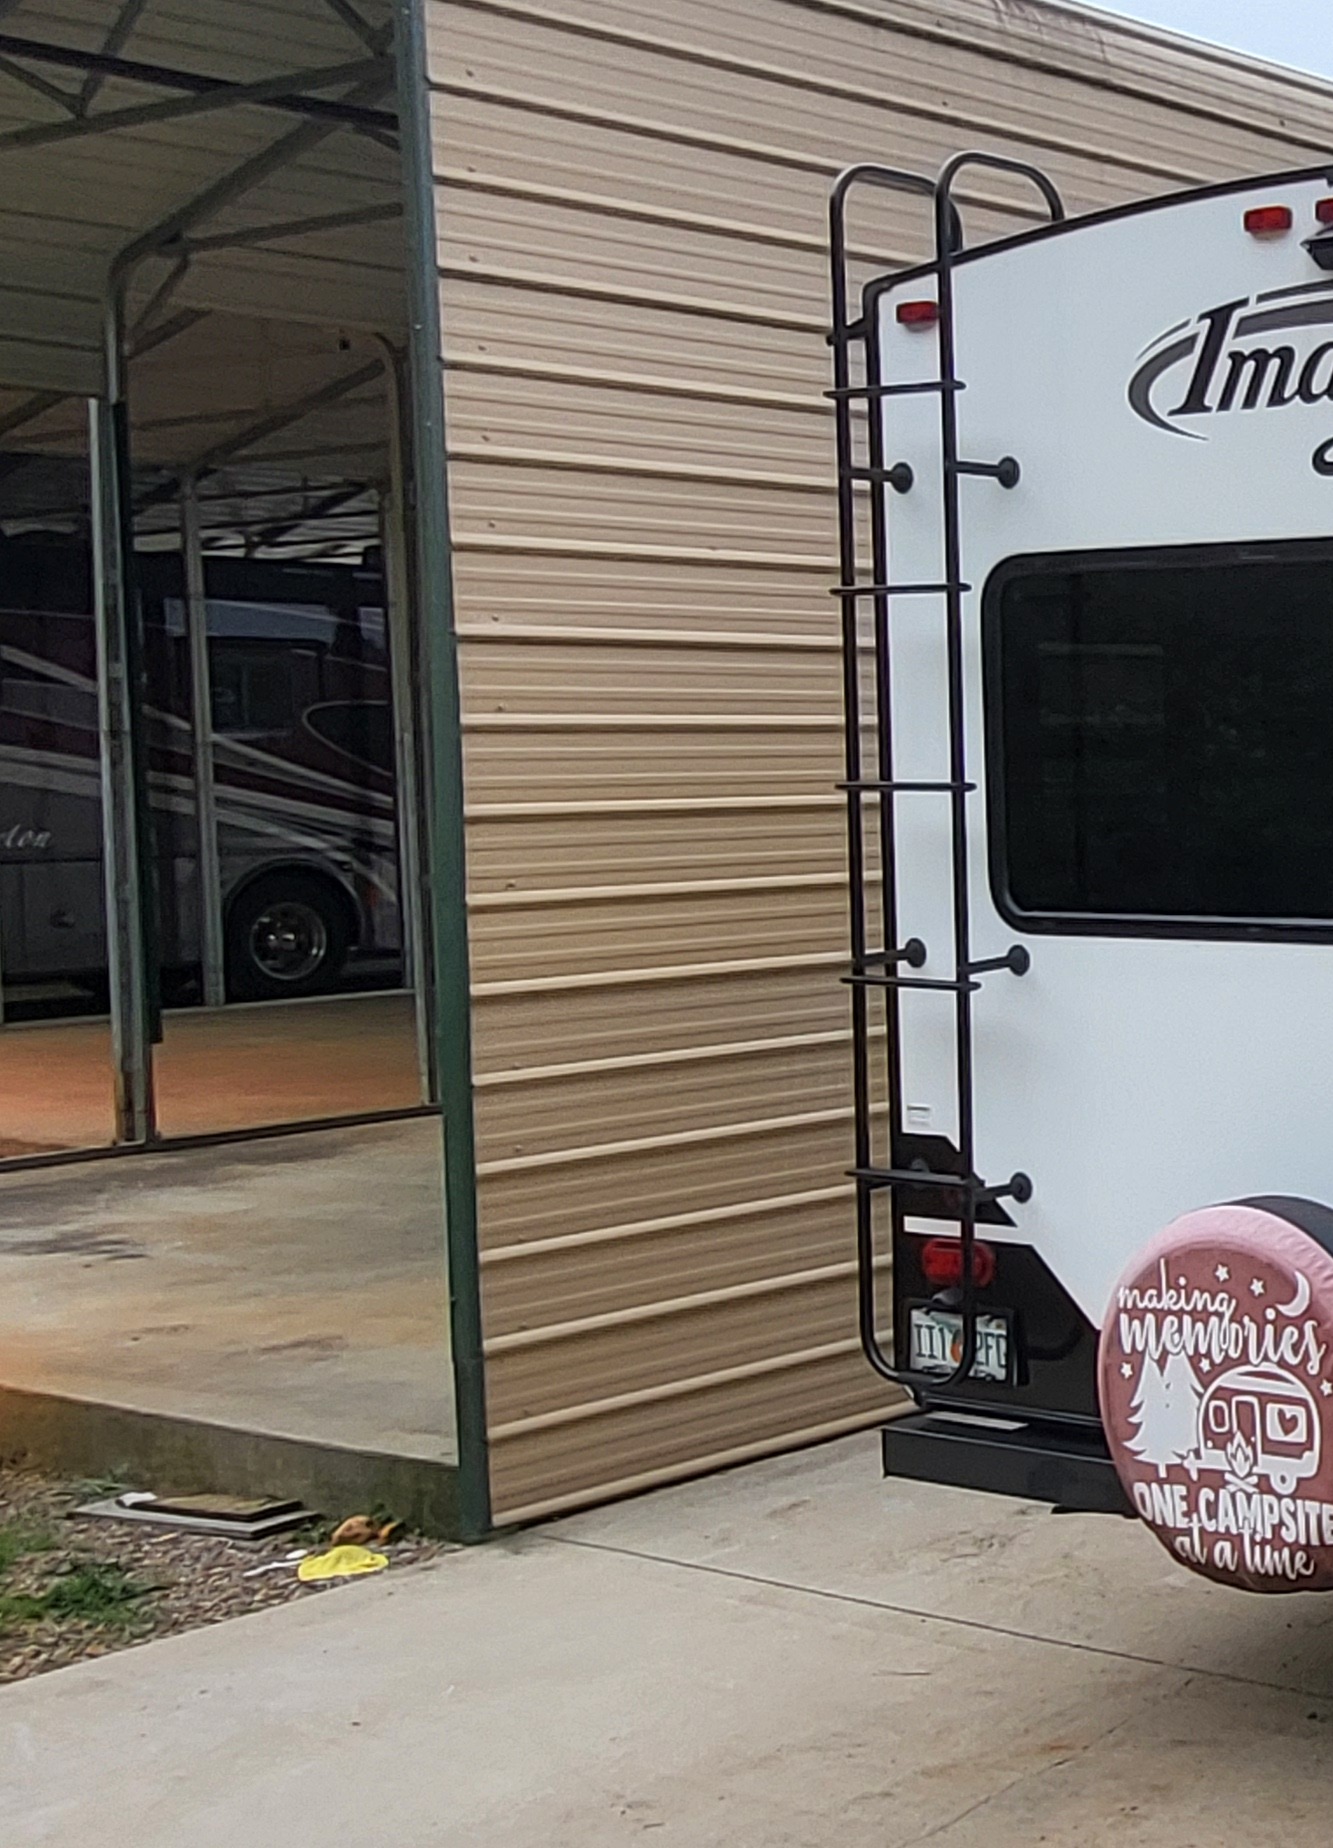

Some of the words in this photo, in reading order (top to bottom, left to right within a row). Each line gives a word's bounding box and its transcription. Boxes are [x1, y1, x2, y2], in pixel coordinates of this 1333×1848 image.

[1117, 1257, 1236, 1349] making
[1120, 1308, 1326, 1375] memories
[1133, 1482, 1190, 1528] ONE
[1174, 1512, 1207, 1564] at
[1213, 1540, 1238, 1572] a
[1237, 1518, 1315, 1580] time
